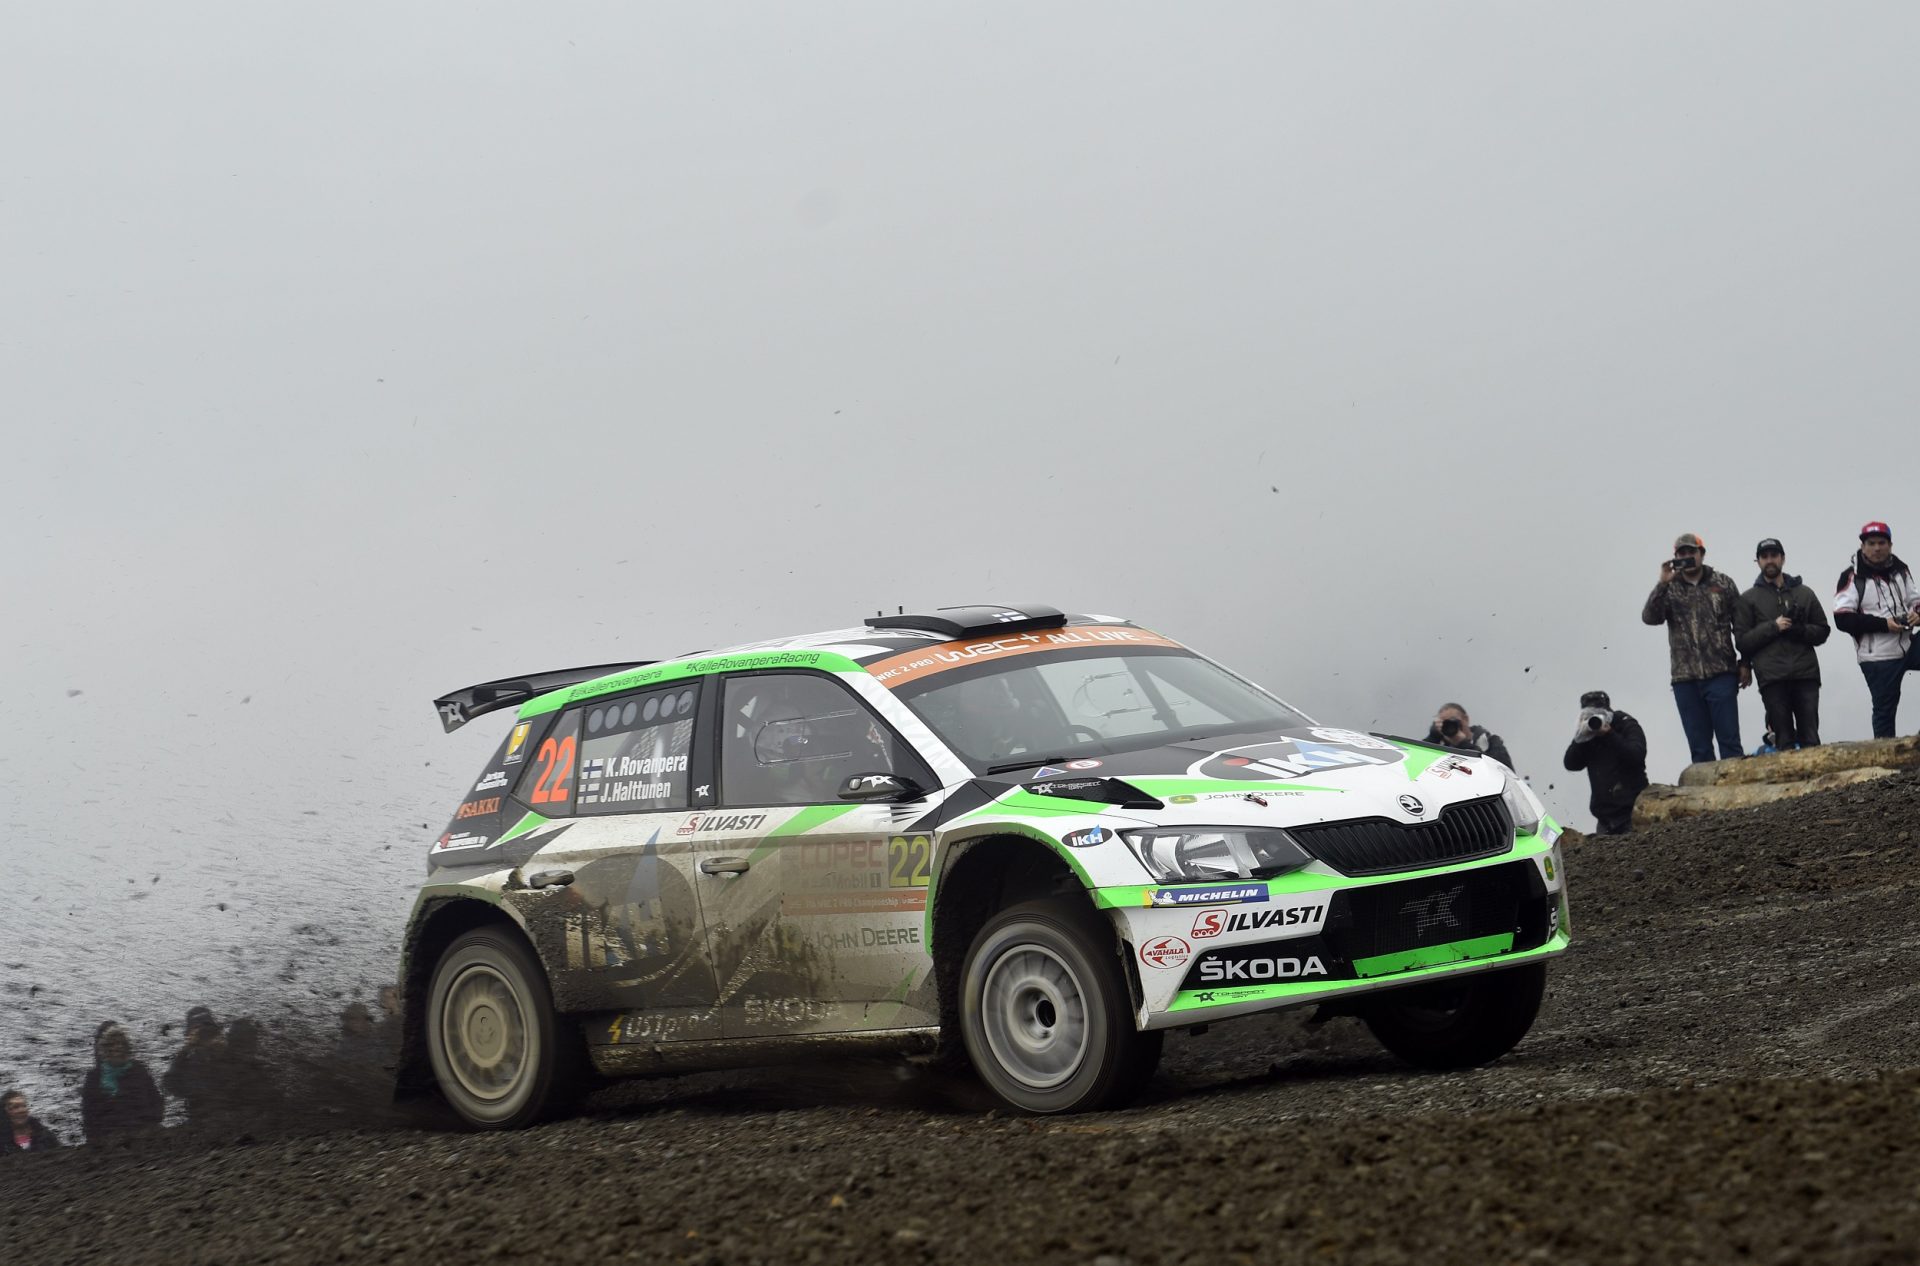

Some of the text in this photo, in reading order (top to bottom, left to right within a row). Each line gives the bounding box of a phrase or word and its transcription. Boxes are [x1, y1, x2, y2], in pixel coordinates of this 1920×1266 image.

[1045, 633, 1092, 644] ALL
[1085, 631, 1141, 641] LIVE
[909, 659, 934, 669] PRO
[530, 735, 577, 803] 22
[600, 780, 671, 803] J.Halttunen
[690, 814, 767, 832] SILVASTI
[888, 835, 930, 887] 22
[1178, 888, 1259, 902] MICHELIN
[1204, 905, 1324, 932] SILVASTI
[815, 927, 920, 950] JOHN DEERE
[1200, 956, 1327, 981] ŠKODA
